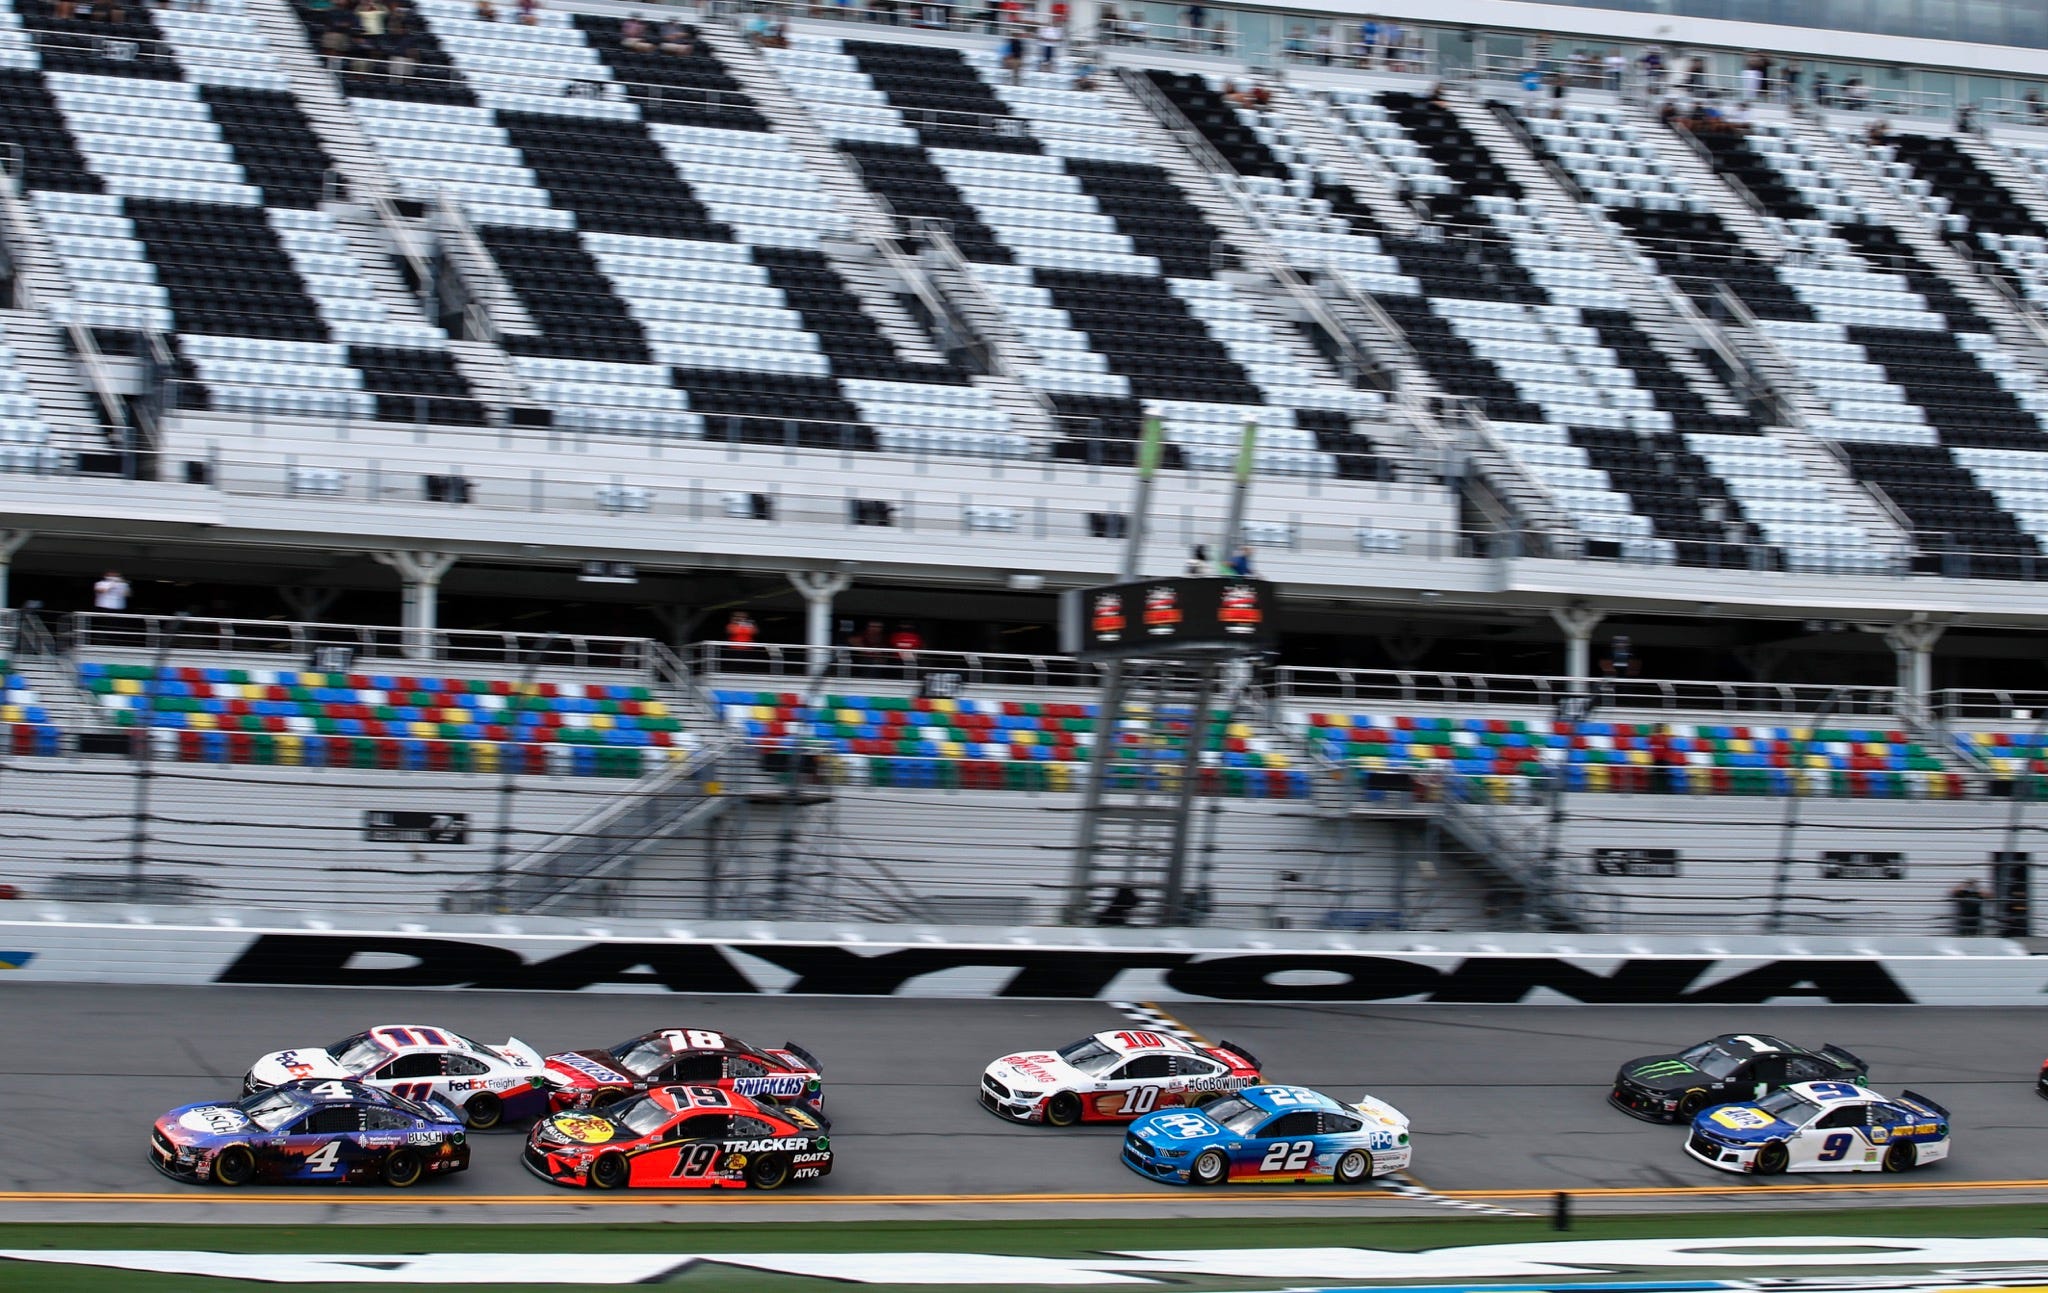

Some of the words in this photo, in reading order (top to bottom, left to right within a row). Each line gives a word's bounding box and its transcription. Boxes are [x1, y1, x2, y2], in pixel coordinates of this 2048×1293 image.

[212, 935, 1916, 1005] DAYTONA
[379, 1028, 449, 1047] 11
[661, 1030, 725, 1051] 18
[1114, 1031, 1164, 1049] 10
[1732, 1035, 1780, 1052] 1
[311, 1080, 354, 1099] 4
[449, 1079, 488, 1092] FedEx
[488, 1078, 516, 1090] Freight
[733, 1077, 806, 1096] SNICKERS
[1808, 1082, 1861, 1101] 9
[667, 1085, 732, 1112] 19
[1116, 1084, 1161, 1115] 10
[1264, 1087, 1323, 1107] 22
[192, 1105, 240, 1135] BUSCH
[407, 1131, 443, 1143] BUSCH
[723, 1138, 808, 1153] TRACKER
[1371, 1132, 1393, 1149] PPG
[304, 1140, 342, 1173] 4
[1259, 1140, 1315, 1173] 22
[1817, 1133, 1854, 1161] 9
[669, 1144, 719, 1179] 19
[793, 1151, 831, 1163] BOATS
[793, 1167, 820, 1179] ATVs
